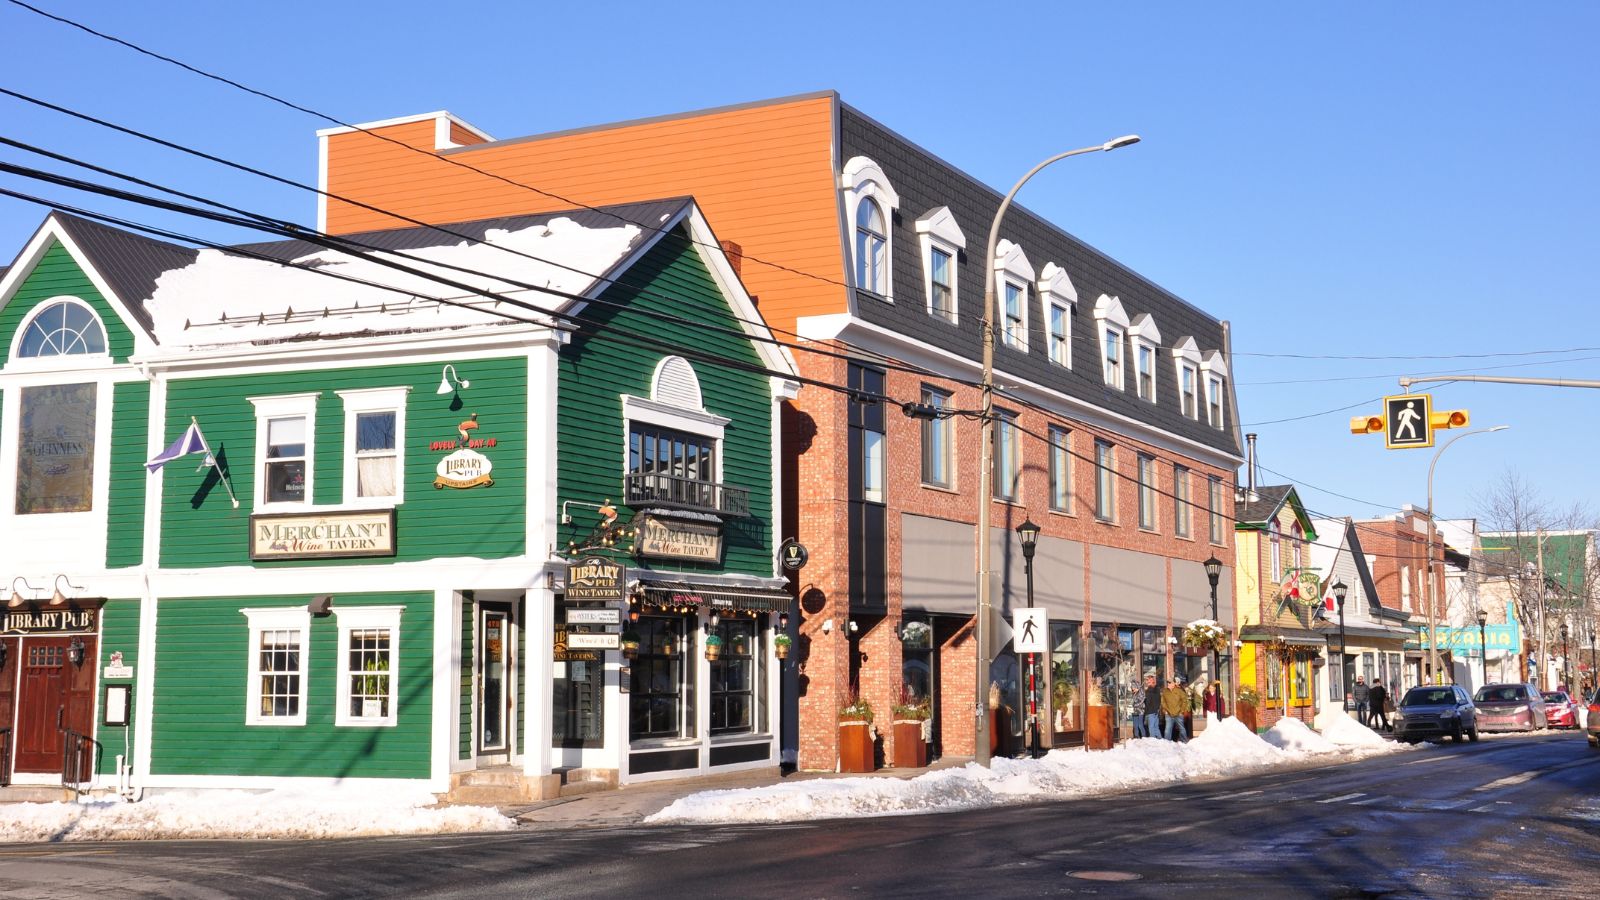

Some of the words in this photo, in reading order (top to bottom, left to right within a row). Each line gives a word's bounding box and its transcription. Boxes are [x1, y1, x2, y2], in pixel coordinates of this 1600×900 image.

[429, 440, 456, 451] LOVELY
[468, 439, 484, 448] DAY
[446, 458, 482, 475] LIBRARY
[259, 522, 387, 541] MERCHANT
[644, 524, 715, 547] MERCHANT
[291, 536, 324, 552] Wine
[327, 538, 377, 550] TAVERN
[660, 539, 681, 555] Wine
[683, 545, 710, 556] TAVERN
[570, 565, 619, 586] LIBRARY
[595, 579, 616, 587] PUB
[568, 588, 590, 597] WINE
[591, 588, 621, 597] TAVERN
[4, 612, 60, 634] LIBRARY
[61, 611, 89, 630] PUB
